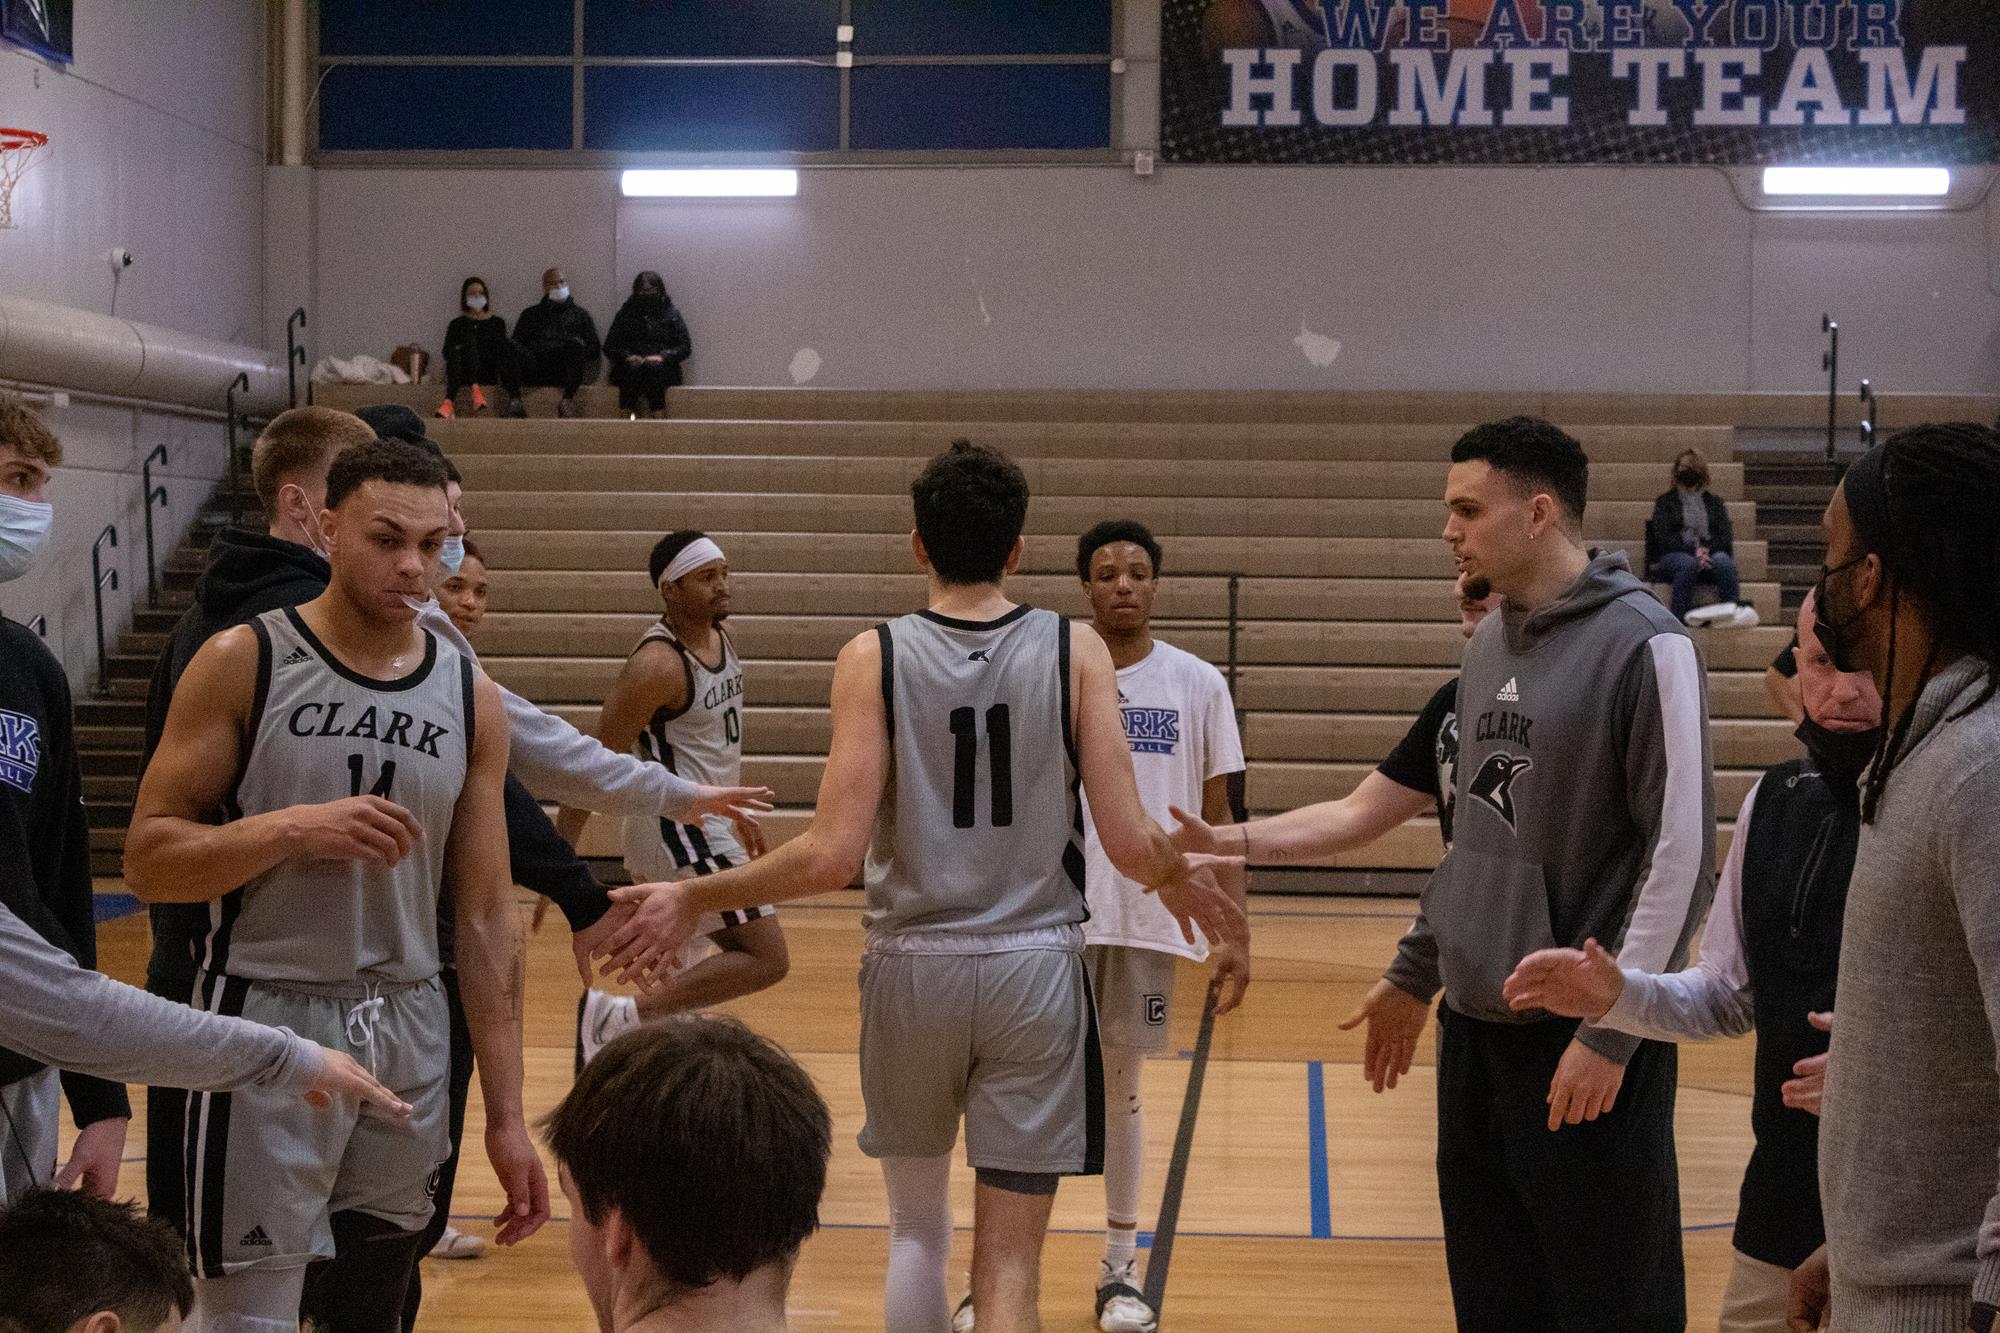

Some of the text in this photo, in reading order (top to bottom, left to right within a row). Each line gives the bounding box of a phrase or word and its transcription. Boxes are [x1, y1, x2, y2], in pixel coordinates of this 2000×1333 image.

[1315, 0, 1905, 53] WE ARE YOUR
[1221, 46, 1968, 126] HOME TEAM
[283, 655, 314, 665] adidas
[704, 674, 743, 710] CLARK
[1496, 692, 1520, 702] adidas
[288, 702, 449, 759] CLARK
[723, 706, 740, 746] 10
[1119, 708, 1179, 742] RK
[1475, 711, 1533, 749] CLARK
[949, 703, 1013, 829] 11
[239, 1238, 273, 1246] adidas
